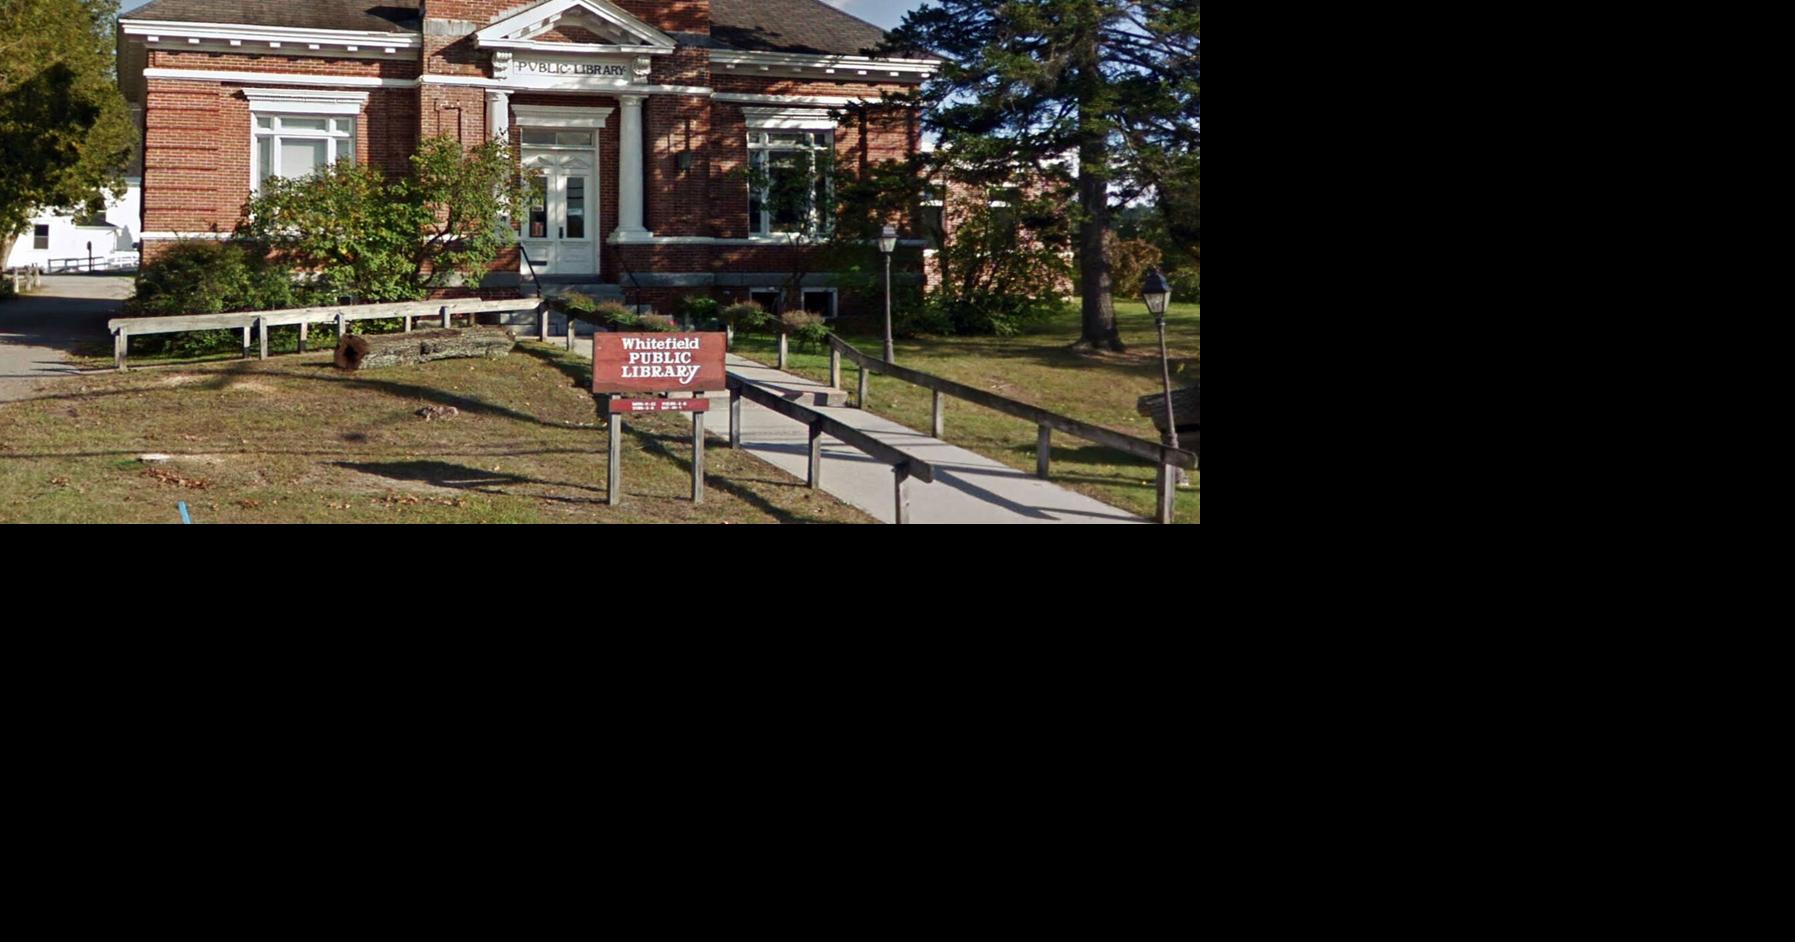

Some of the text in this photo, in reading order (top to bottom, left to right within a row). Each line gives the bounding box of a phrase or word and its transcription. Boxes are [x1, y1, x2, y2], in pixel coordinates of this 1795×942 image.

[574, 64, 625, 76] LIBRARY
[621, 337, 700, 350] Whitefield
[628, 351, 692, 365] PUBLIC
[621, 365, 701, 385] LIBRARY
